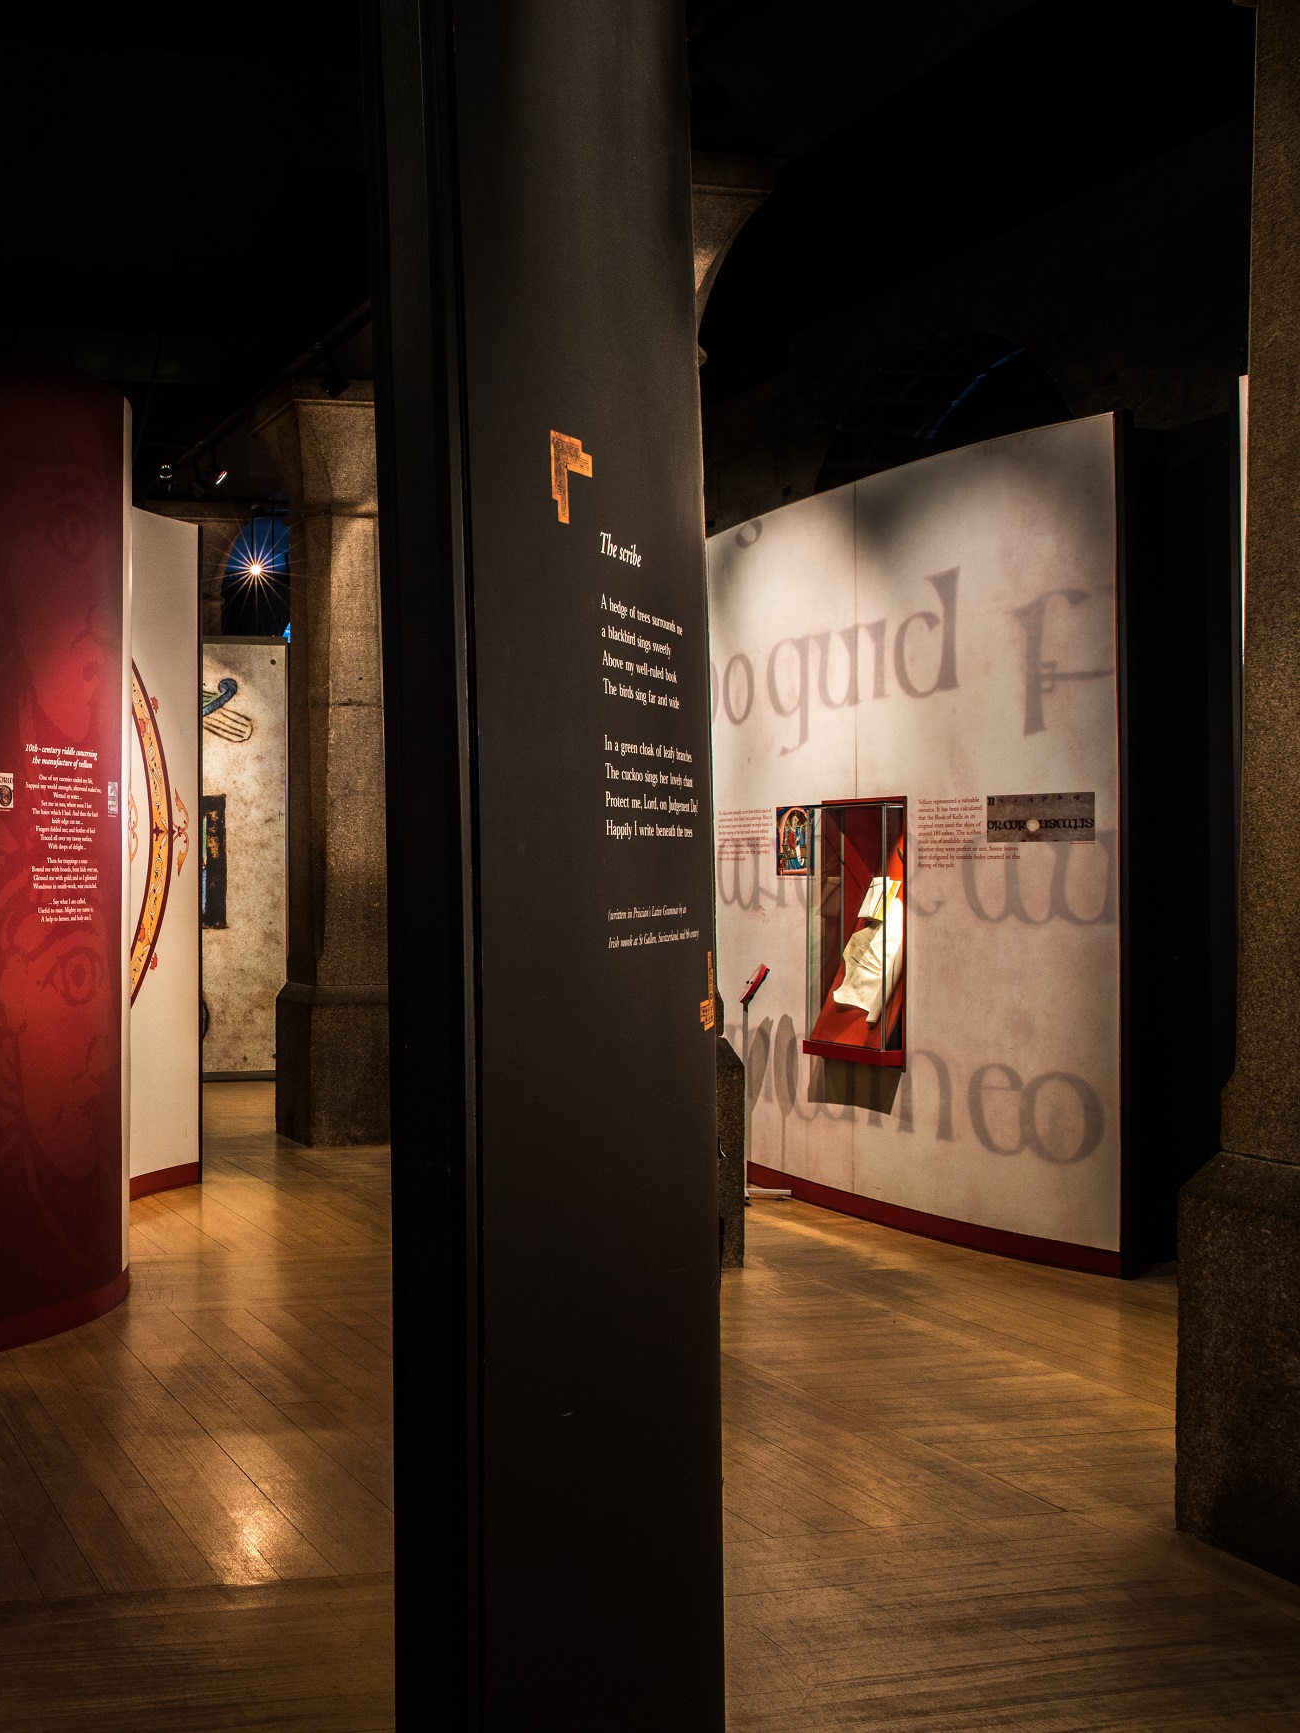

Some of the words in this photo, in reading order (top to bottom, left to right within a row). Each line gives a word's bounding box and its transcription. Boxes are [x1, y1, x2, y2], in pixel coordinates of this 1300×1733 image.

[600, 531, 617, 558] The
[619, 544, 641, 568] scribe
[601, 594, 607, 610] A
[609, 598, 628, 619] hedge
[630, 606, 636, 619] of
[637, 610, 651, 623] trees
[652, 616, 676, 633] surrounds
[676, 625, 683, 636] me
[601, 627, 605, 637] a
[608, 625, 636, 646] blackbird
[637, 635, 651, 653] sings
[653, 643, 671, 659] sweetly
[602, 650, 623, 669] Above
[625, 661, 634, 676] my
[636, 662, 664, 679] well-ruled
[665, 668, 677, 683] book
[603, 677, 617, 695] The
[619, 683, 634, 699] birds
[635, 688, 647, 705] sing
[648, 690, 656, 703] far
[658, 694, 667, 706] and
[669, 697, 680, 709] wide
[32, 756, 41, 764] the
[42, 758, 72, 768] manufacture
[73, 759, 79, 770] of
[42, 747, 61, 757] century
[62, 746, 75, 756] riddle
[76, 750, 98, 761] concerning
[605, 734, 612, 751] In
[614, 742, 619, 751] a
[621, 742, 638, 756] green
[640, 742, 654, 756] cloak
[656, 744, 662, 757] of
[663, 745, 675, 763] leafy
[676, 748, 692, 763] branches
[605, 763, 619, 779] The
[622, 768, 643, 781] cuckoo
[645, 770, 658, 787] sings
[659, 771, 669, 784] her
[670, 772, 682, 789] lovely
[605, 791, 629, 808] Protect
[632, 798, 642, 810] me,
[644, 794, 658, 811] Lord,
[660, 800, 667, 810] on
[668, 796, 690, 815] Judgement
[606, 820, 632, 840] Happily
[634, 820, 637, 835] I
[639, 824, 654, 836] write
[656, 824, 675, 836] beneath
